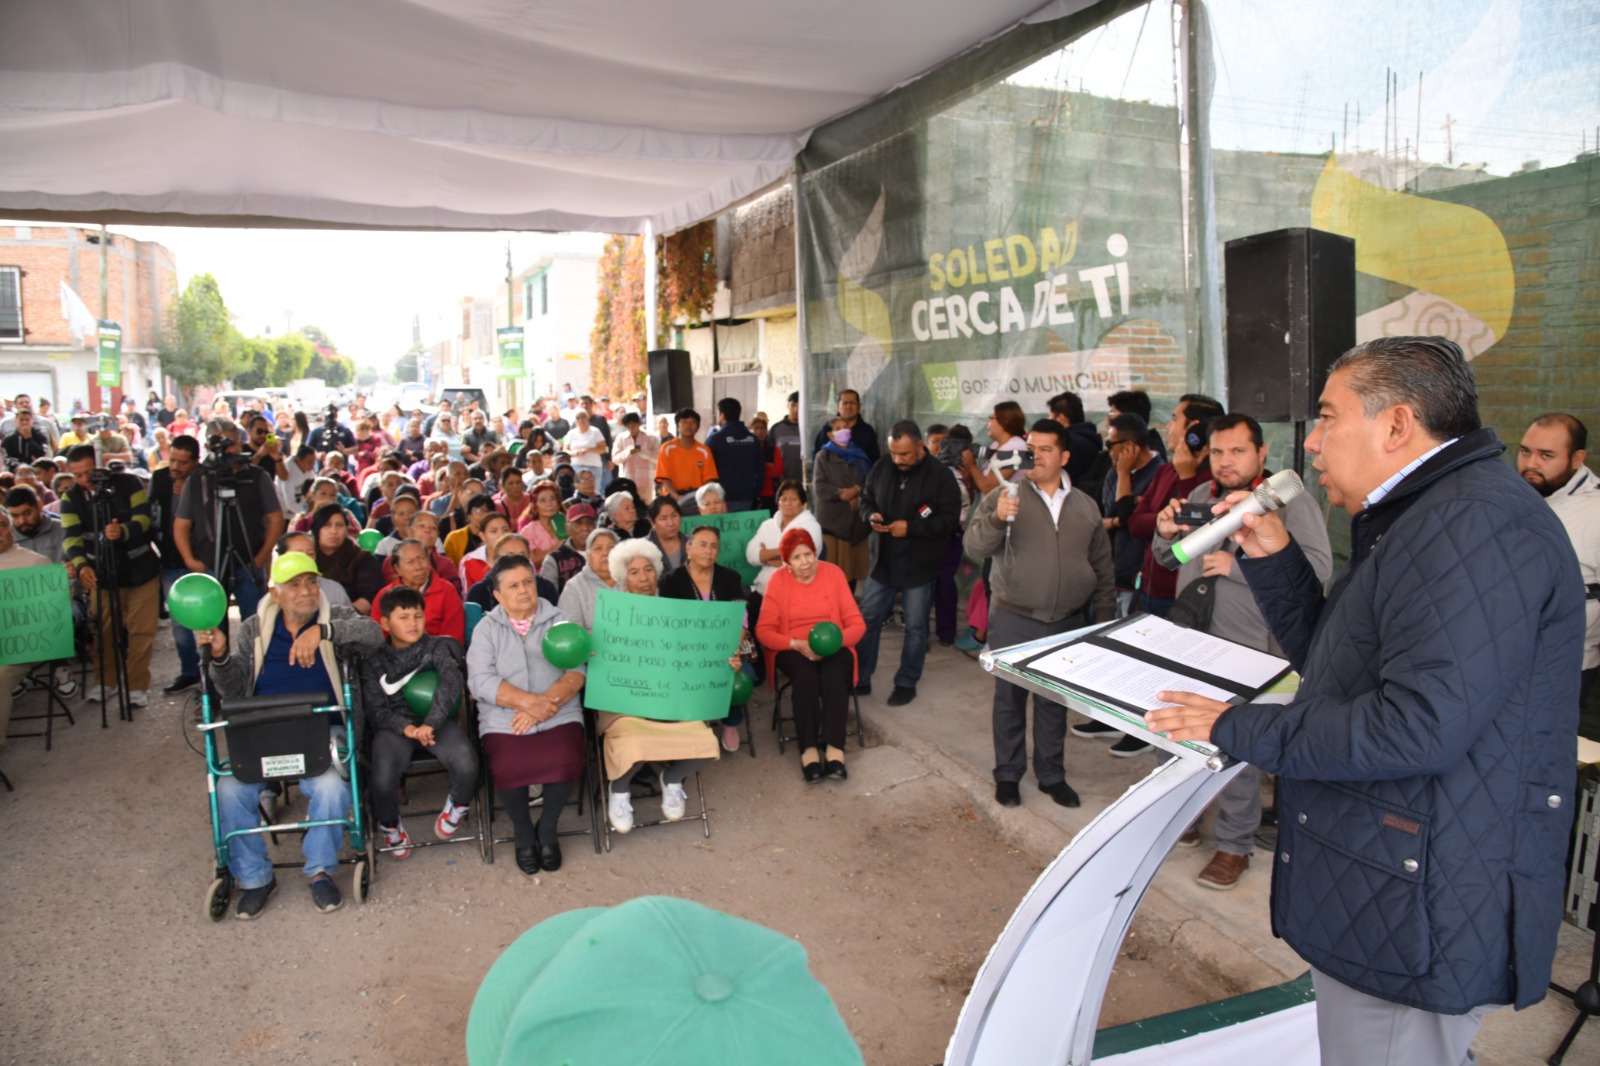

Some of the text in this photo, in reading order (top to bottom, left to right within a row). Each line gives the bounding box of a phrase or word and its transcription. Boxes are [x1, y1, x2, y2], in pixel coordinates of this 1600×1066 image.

[911, 286, 1025, 341] CERCA
[1031, 273, 1075, 329] DE
[932, 376, 957, 388] 2024
[1024, 371, 1126, 393] MUNICIPAL
[935, 388, 958, 400] 2027
[0, 568, 68, 601] RUYENDO
[2, 597, 62, 630] DIGNAS
[715, 642, 729, 651] en
[671, 657, 693, 672] que
